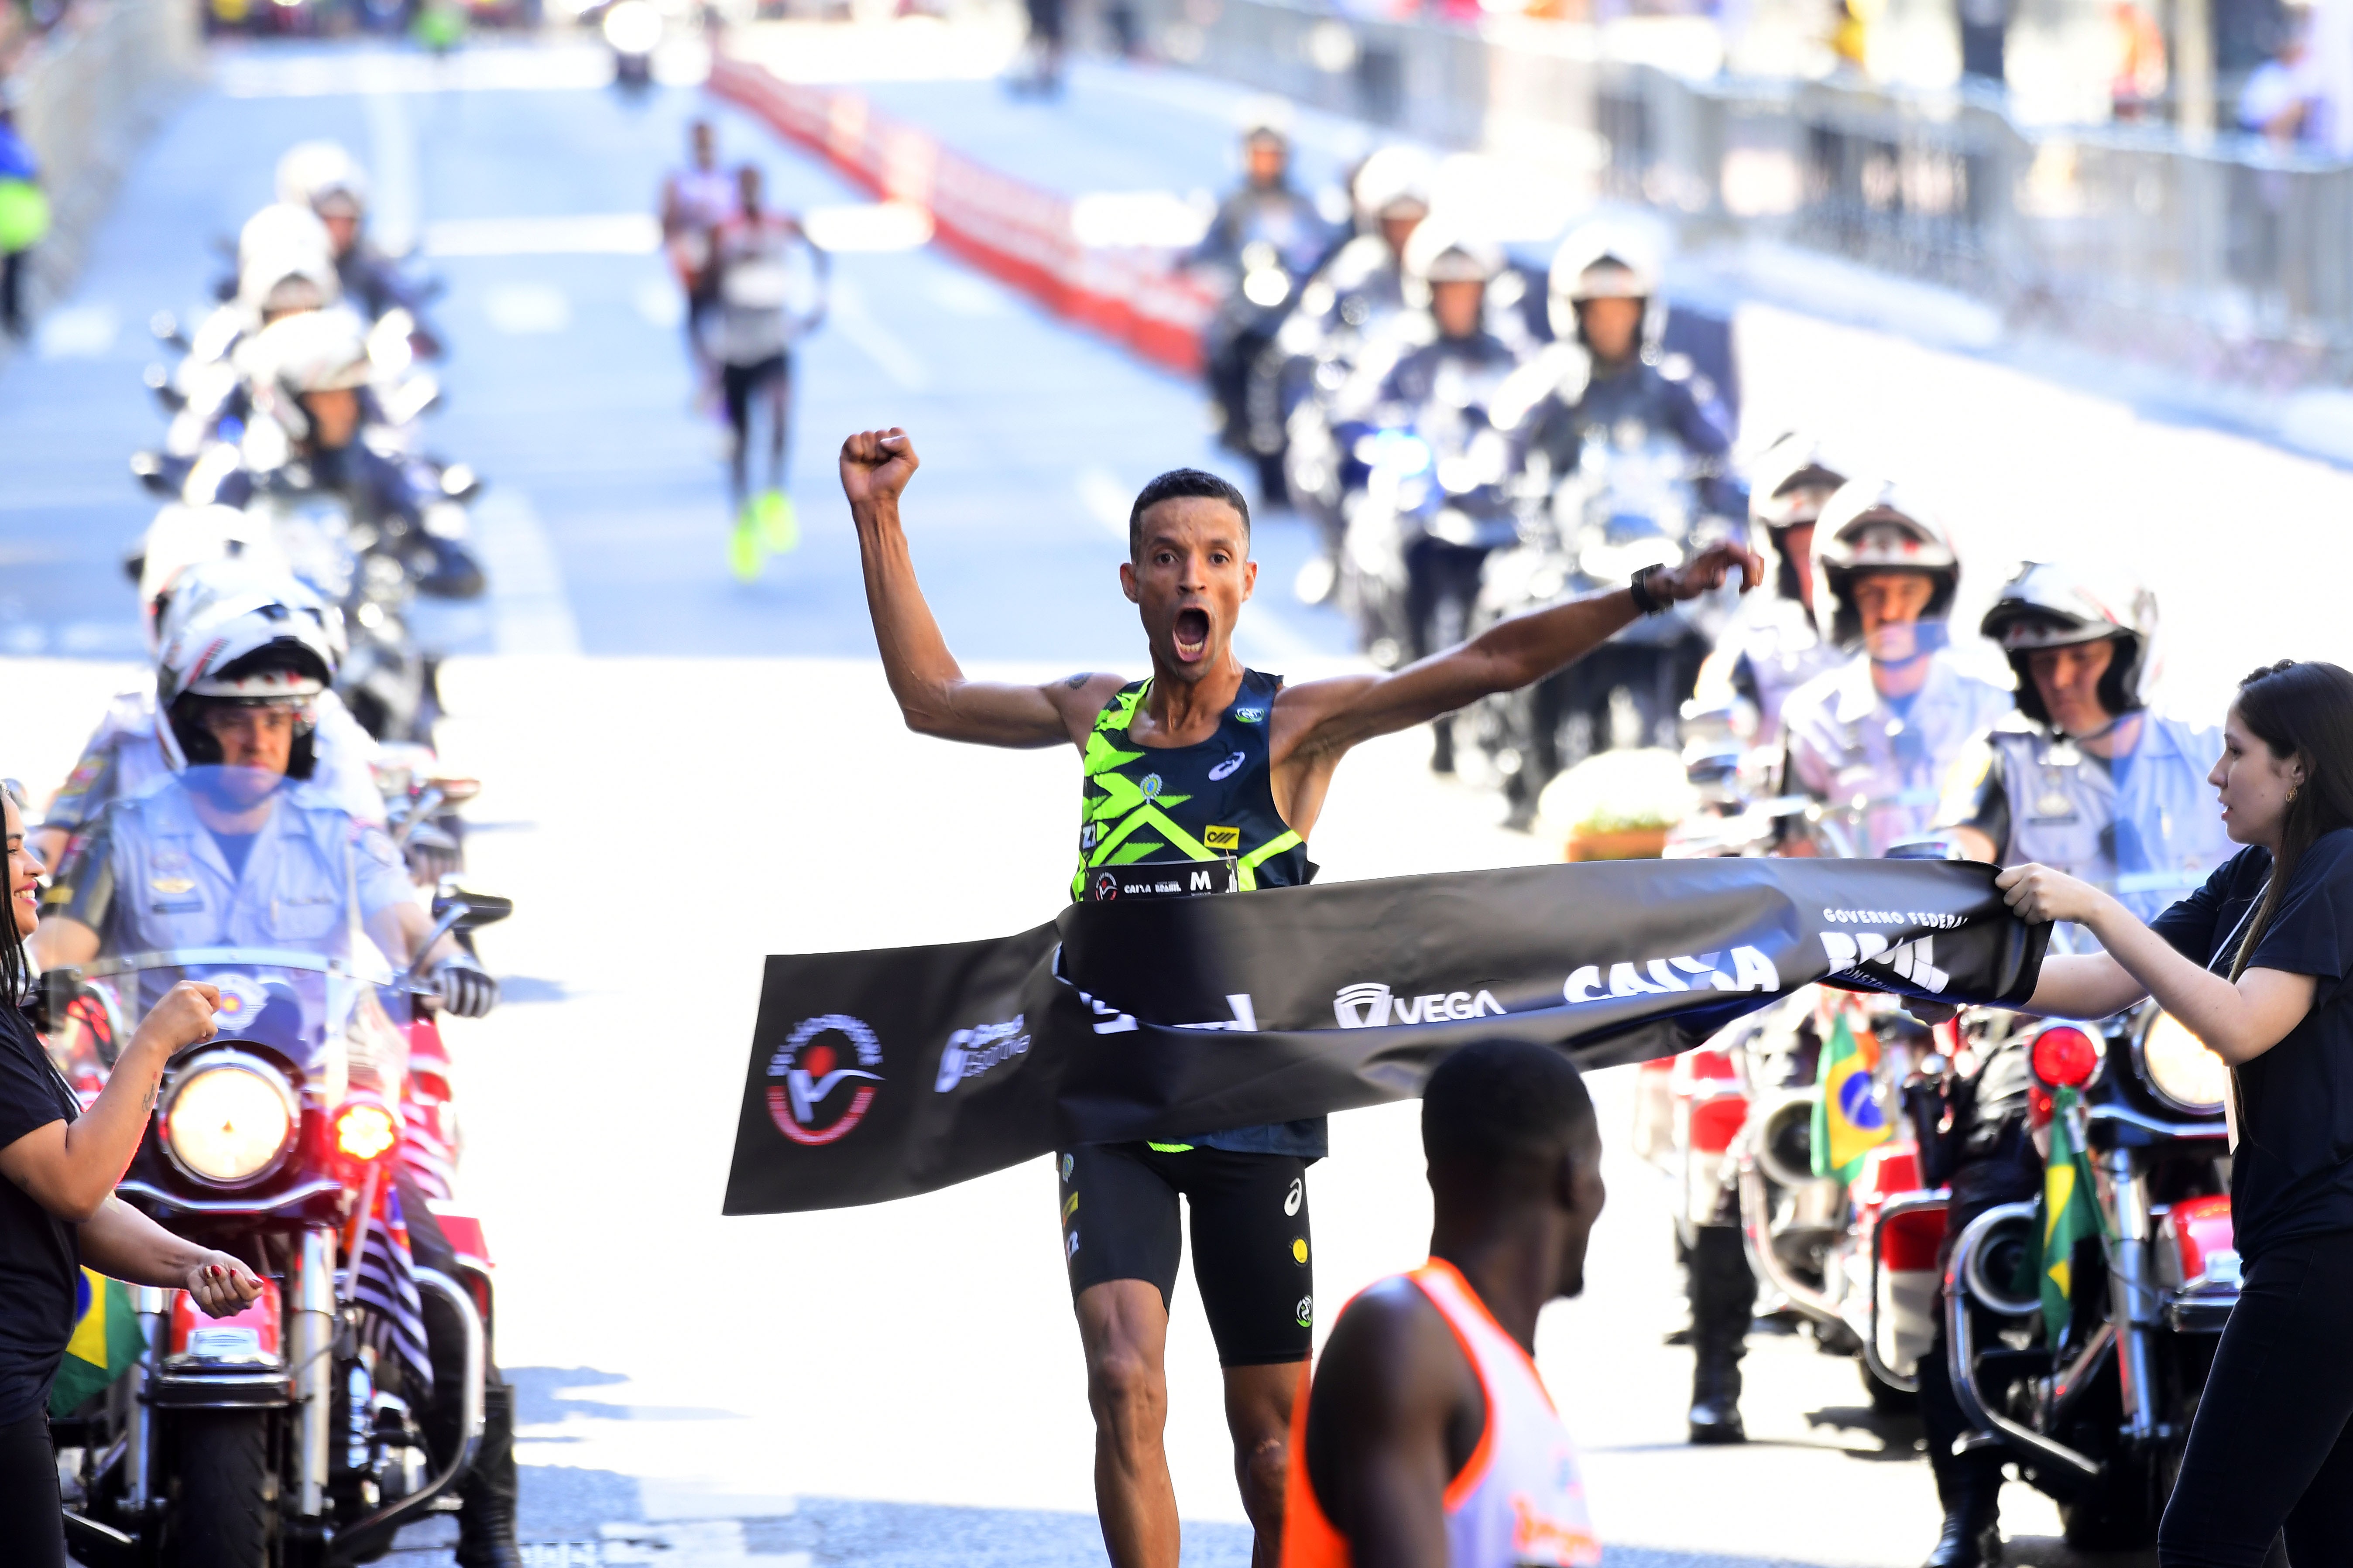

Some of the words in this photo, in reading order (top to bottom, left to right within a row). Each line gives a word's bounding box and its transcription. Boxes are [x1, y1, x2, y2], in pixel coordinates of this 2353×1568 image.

[1823, 908, 1905, 925] GOVERNO
[1563, 945, 1780, 1003] CAIXA
[1394, 989, 1507, 1025] VEGA
